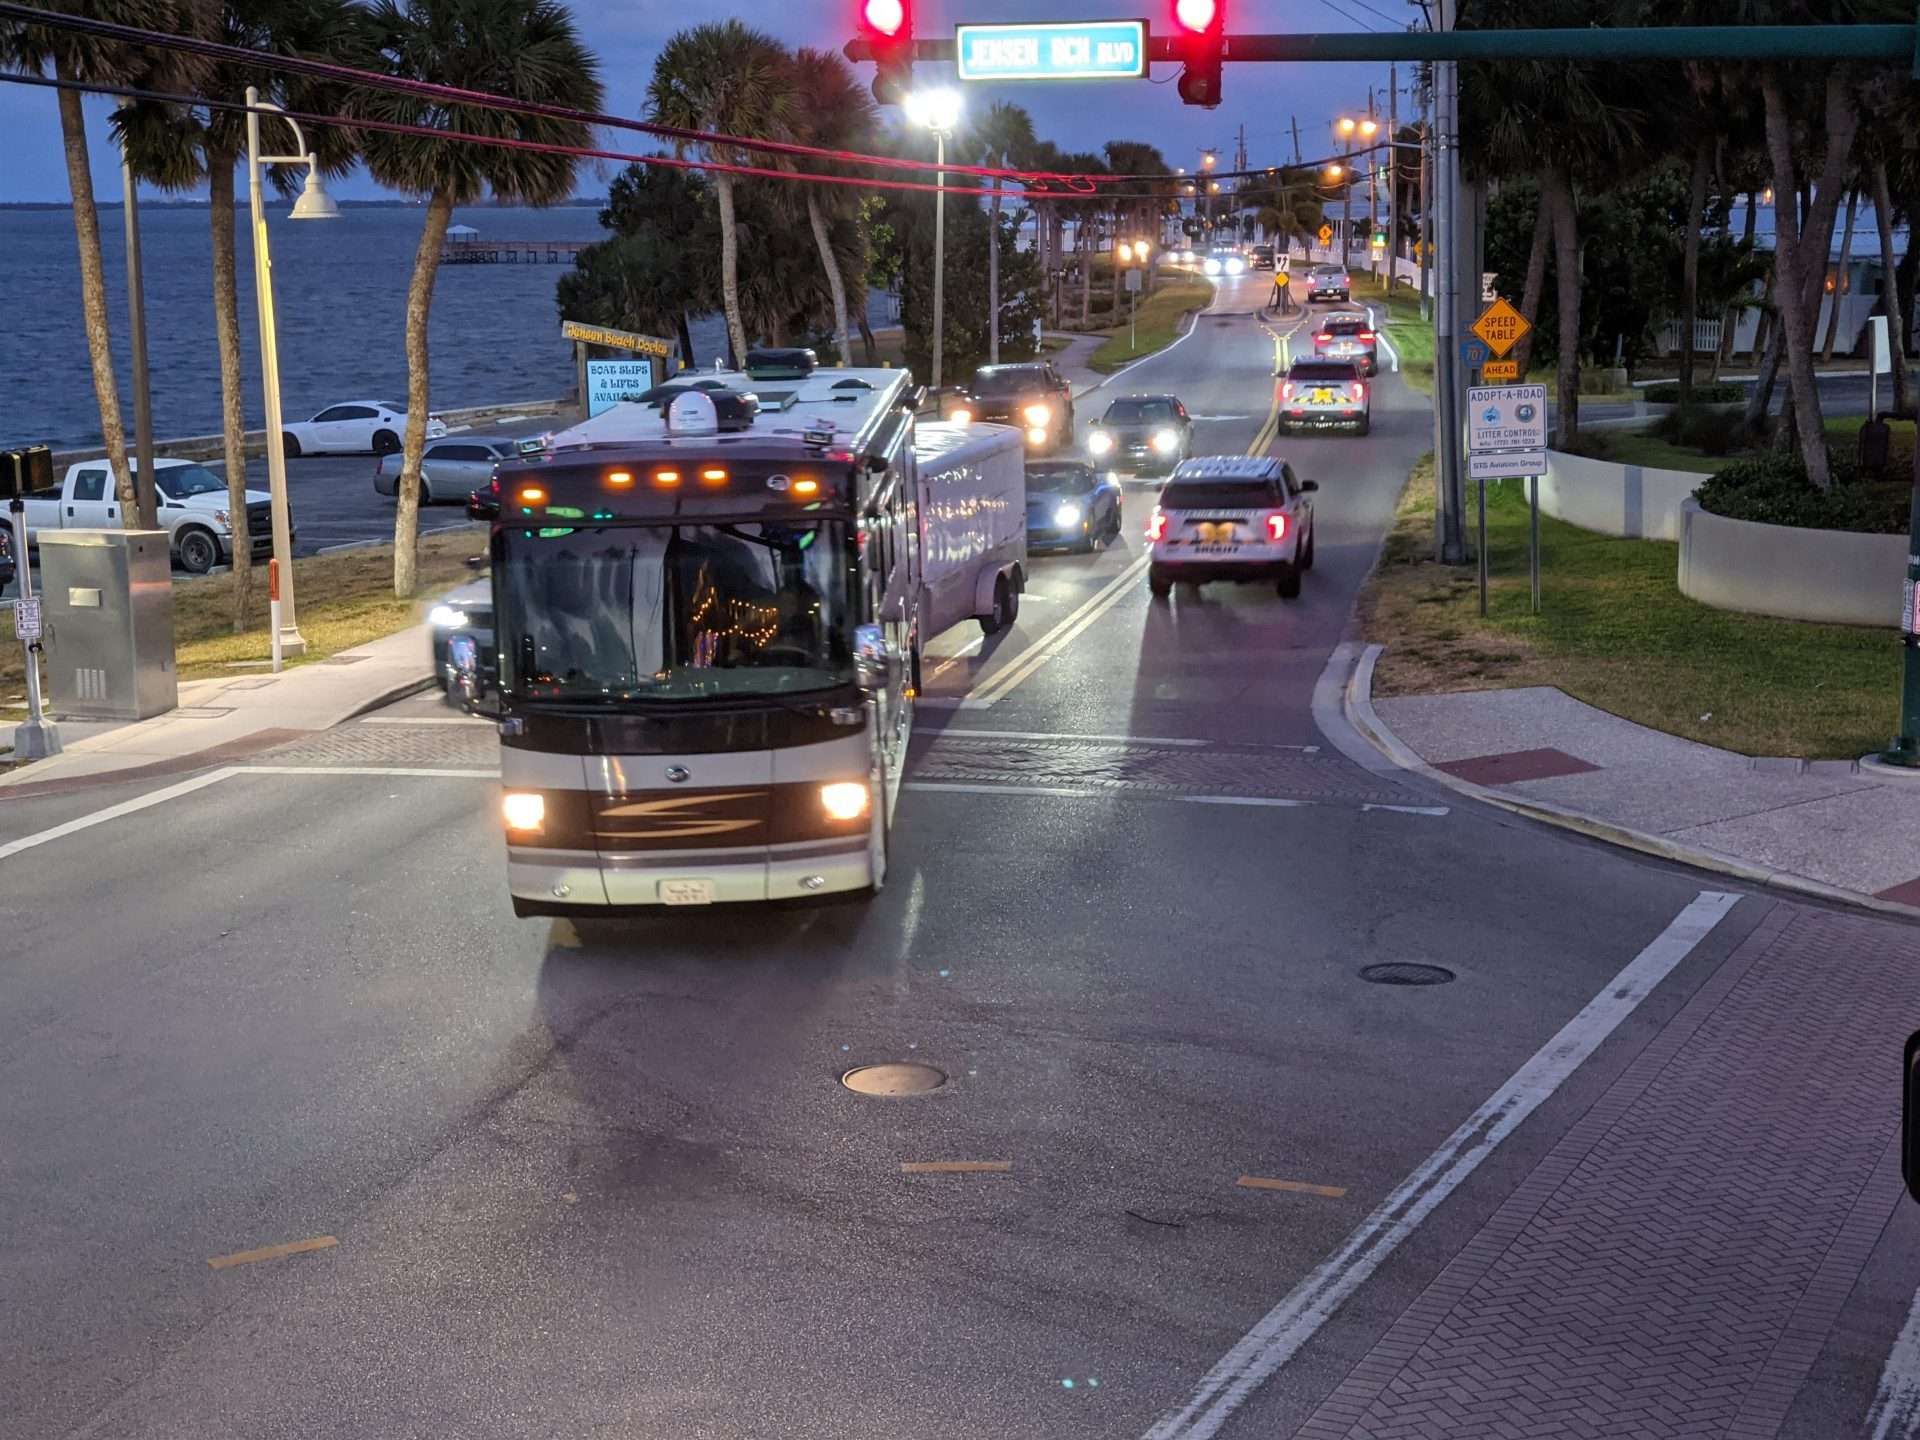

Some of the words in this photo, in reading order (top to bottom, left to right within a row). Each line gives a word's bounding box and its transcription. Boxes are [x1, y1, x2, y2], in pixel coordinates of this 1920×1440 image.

[968, 38, 1038, 66] JENSEN
[1051, 37, 1090, 65] BCH
[1097, 41, 1134, 64] BLVD
[1484, 316, 1516, 328] SPEED
[1485, 329, 1515, 340] TABLE
[590, 365, 616, 375] BOAT
[619, 365, 648, 375] SLIPS
[1486, 364, 1516, 375] AHEAD
[1471, 388, 1543, 401] ADOPT-A-ROAD
[1477, 430, 1502, 440] LITTER
